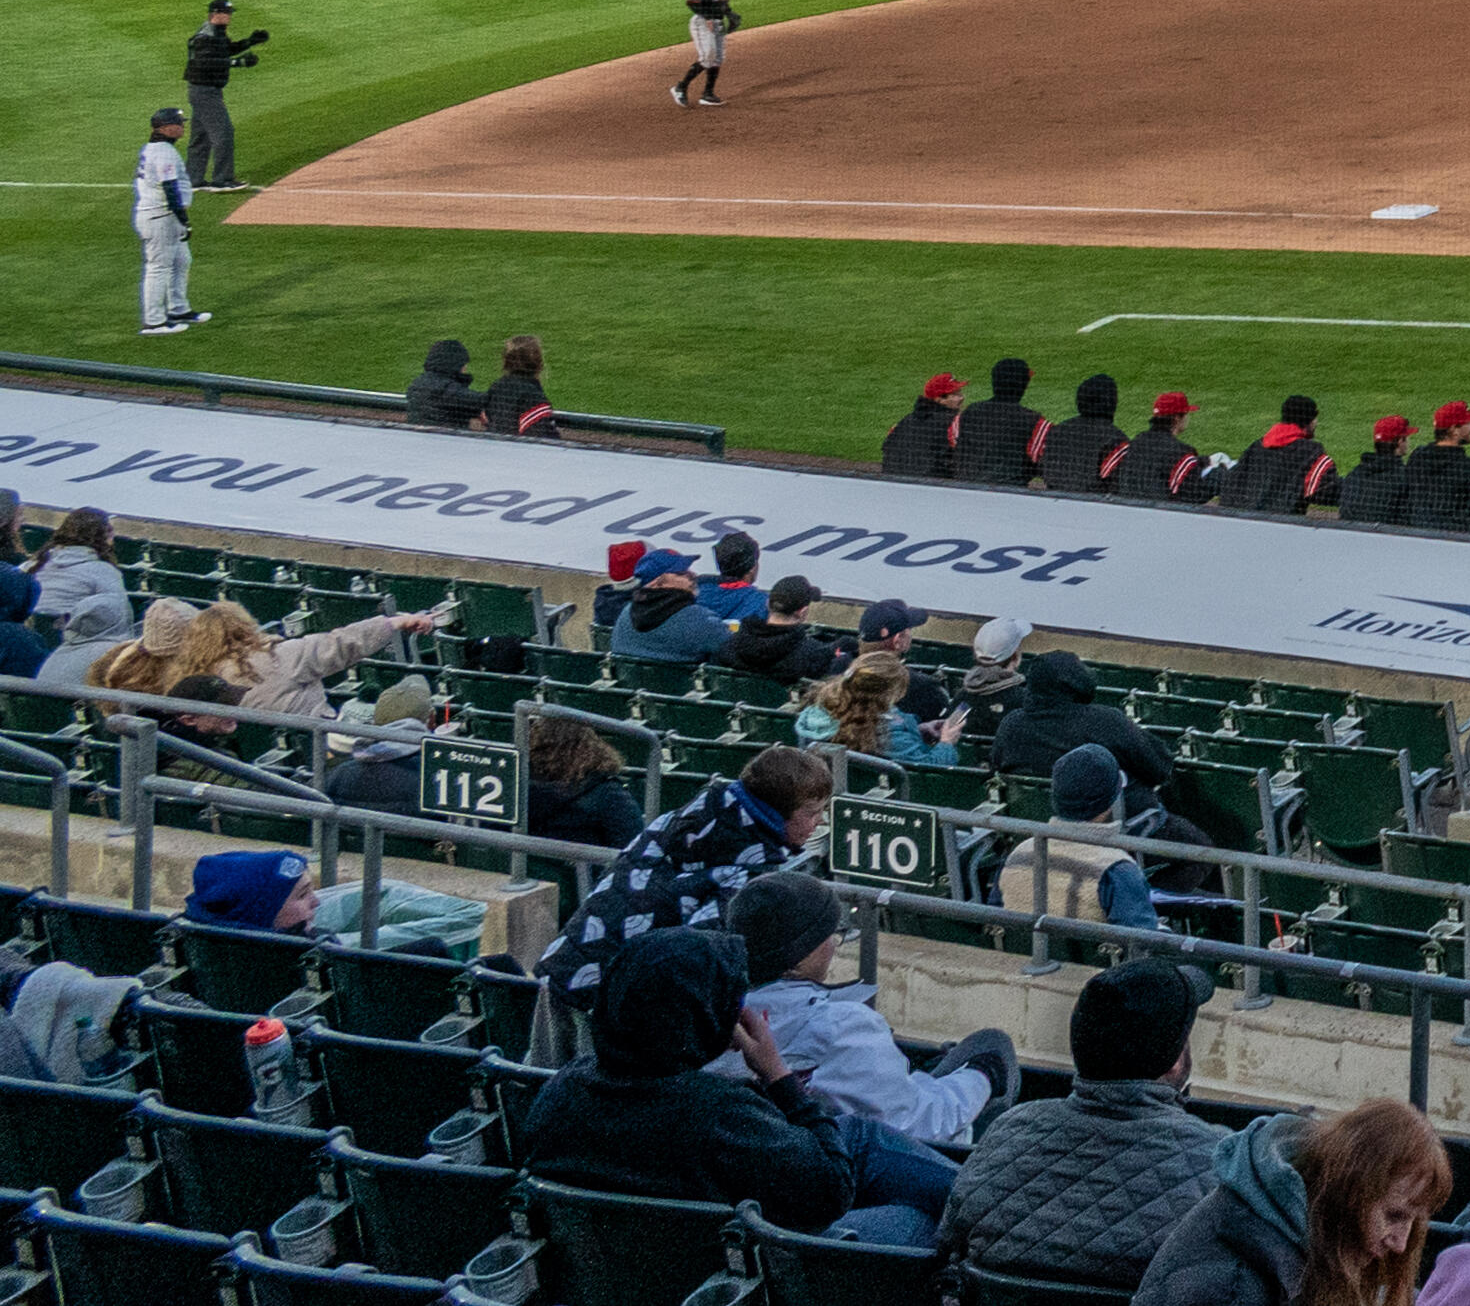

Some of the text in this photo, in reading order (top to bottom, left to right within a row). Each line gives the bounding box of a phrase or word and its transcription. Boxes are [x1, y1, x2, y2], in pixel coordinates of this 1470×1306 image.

[68, 449, 1110, 586] you need us most.
[449, 750, 492, 766] SECTION
[434, 768, 505, 814] 112
[860, 809, 907, 826] SECTION
[843, 829, 920, 875] 110
